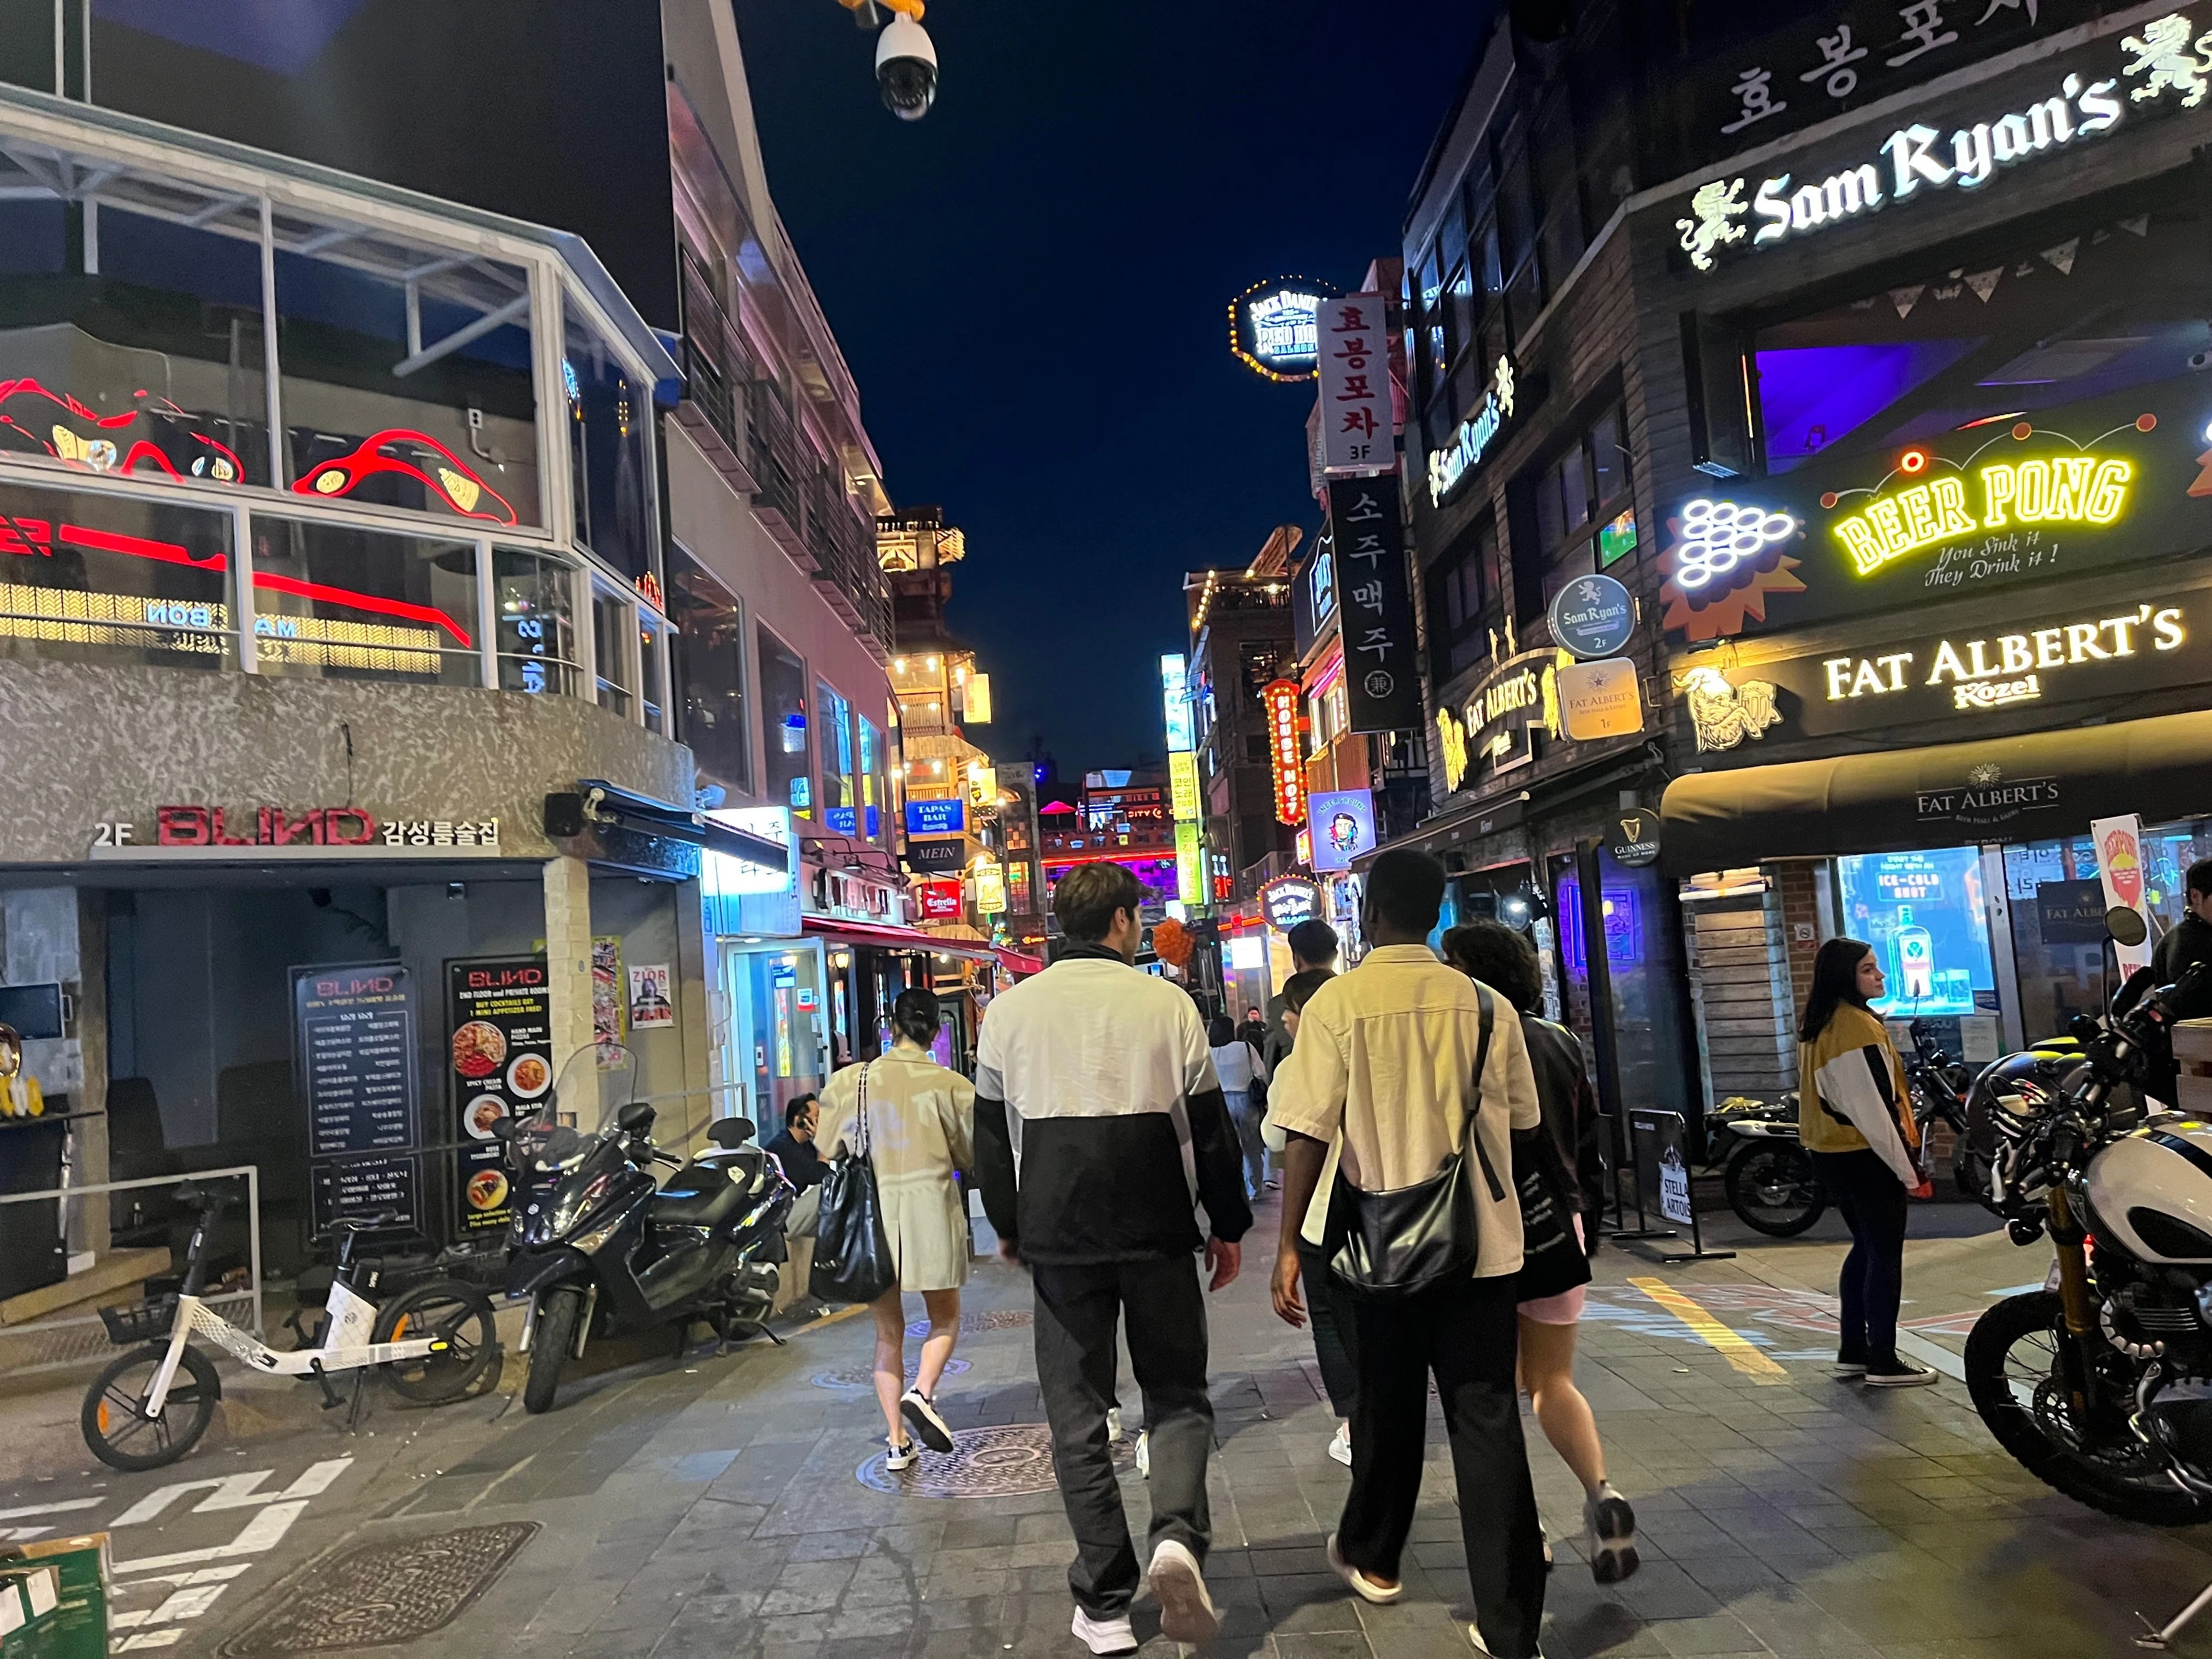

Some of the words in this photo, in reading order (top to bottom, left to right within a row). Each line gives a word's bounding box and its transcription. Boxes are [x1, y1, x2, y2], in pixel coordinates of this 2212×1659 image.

[1754, 163, 1884, 245] Sam
[1880, 72, 2122, 199] Ryan's
[1331, 306, 1379, 439] 효봉포차
[1350, 445, 1370, 460] 3F
[1833, 475, 1977, 577] BEER
[1980, 455, 2133, 528] PONG
[1938, 547, 1974, 569] You
[1980, 533, 2019, 556] Sink
[2026, 530, 2040, 547] it
[1925, 564, 1963, 586] They
[1970, 554, 2021, 579] Drink
[2028, 551, 2043, 567] it
[1564, 611, 1588, 625] Sam
[1587, 603, 1628, 621] Ryan's
[1593, 637, 1607, 649] 2F
[1822, 652, 1914, 702] FAT
[1924, 603, 2187, 685] ALBERT'S
[1570, 698, 1587, 709] FAT
[1590, 691, 1635, 707] ALBERT'S
[1953, 673, 2042, 712] Kozel
[1466, 698, 1485, 739] FAT
[1486, 667, 1537, 723] ALBERT'S
[1600, 719, 1611, 729] 1F
[1317, 797, 1368, 816] UNDERGROUND
[1917, 795, 1955, 813] FAT
[1960, 781, 2059, 810] ALBERT'S
[917, 805, 952, 814] TAPAS
[923, 814, 946, 822] BAR
[94, 822, 134, 847] 2F
[381, 820, 500, 847] 감성룸술집
[918, 847, 956, 860] MEIN
[1615, 842, 1655, 854] GUINNESS
[1878, 873, 1939, 887] ICE-COLD
[926, 897, 957, 907] Estrella
[2047, 909, 2068, 920] FAT
[2073, 906, 2107, 919] ALBE
